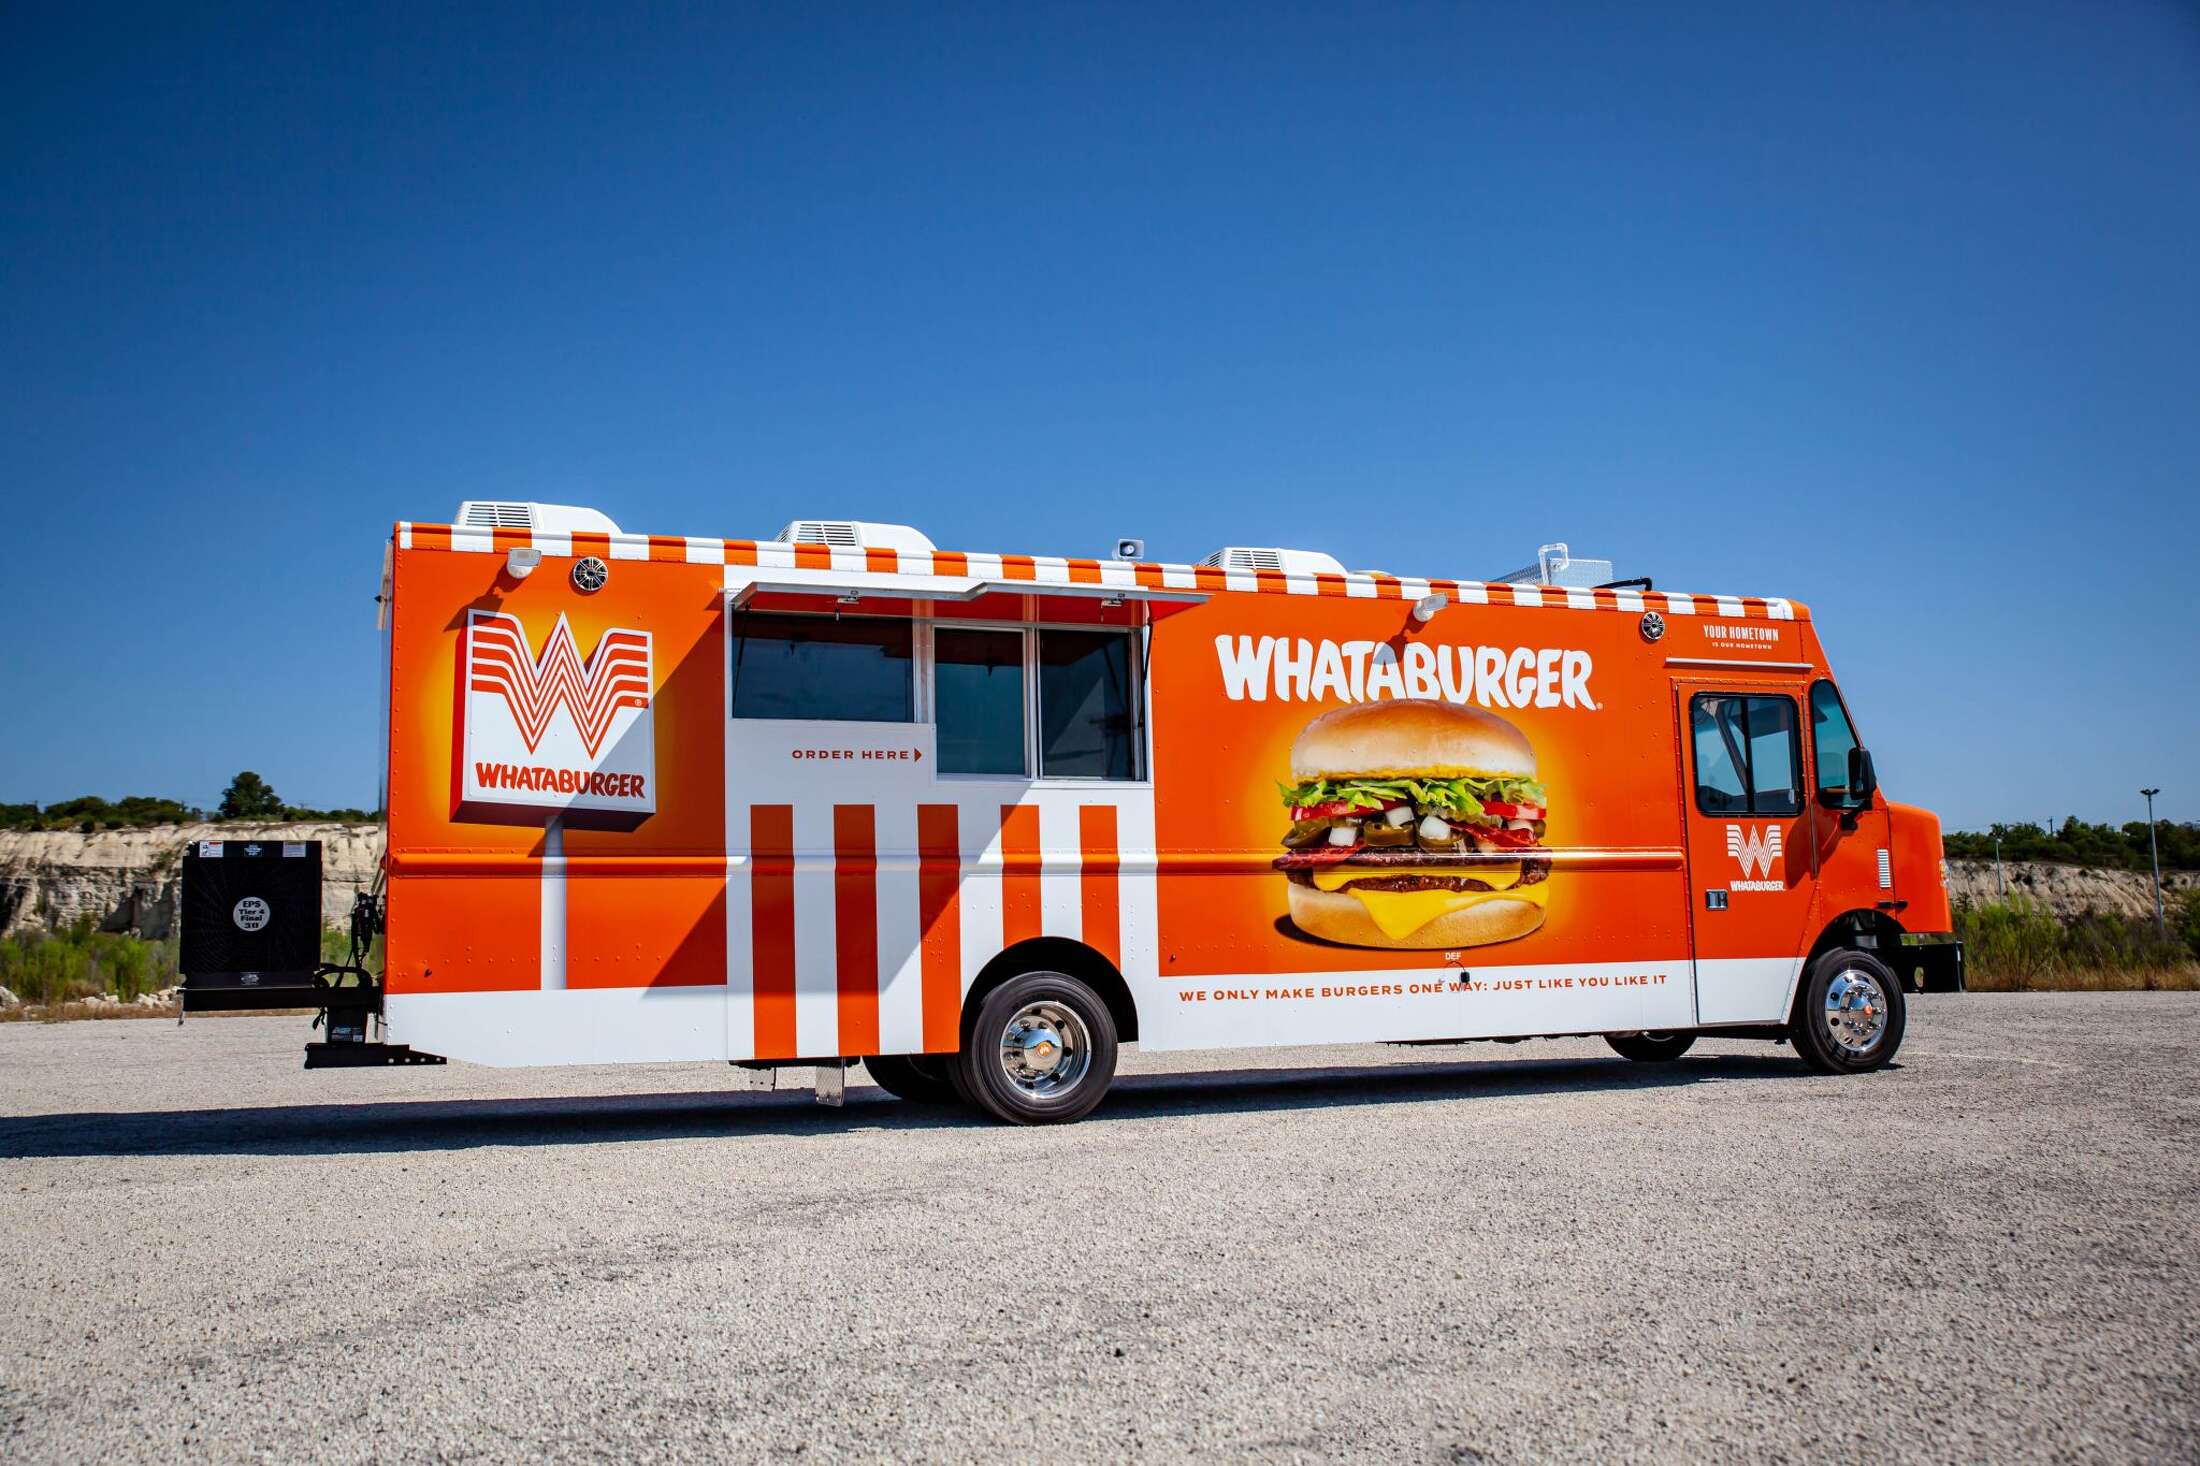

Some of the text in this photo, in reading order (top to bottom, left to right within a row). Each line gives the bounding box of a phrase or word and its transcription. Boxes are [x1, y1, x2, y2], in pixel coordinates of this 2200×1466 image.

[1703, 624, 1779, 641] YOUR HOMETOWN
[1215, 634, 1597, 711] WHATABURGER
[791, 750, 909, 760] ORDER HERE
[475, 762, 645, 799] WHATABURGER
[1730, 880, 1784, 892] WHATABURGER
[242, 900, 261, 908] EPS
[1445, 952, 1461, 961] DEF
[1180, 974, 1667, 1001] WE ONLY MAKE BURGERS ONE WAY: JUST LIKE YOU LIKE IT
